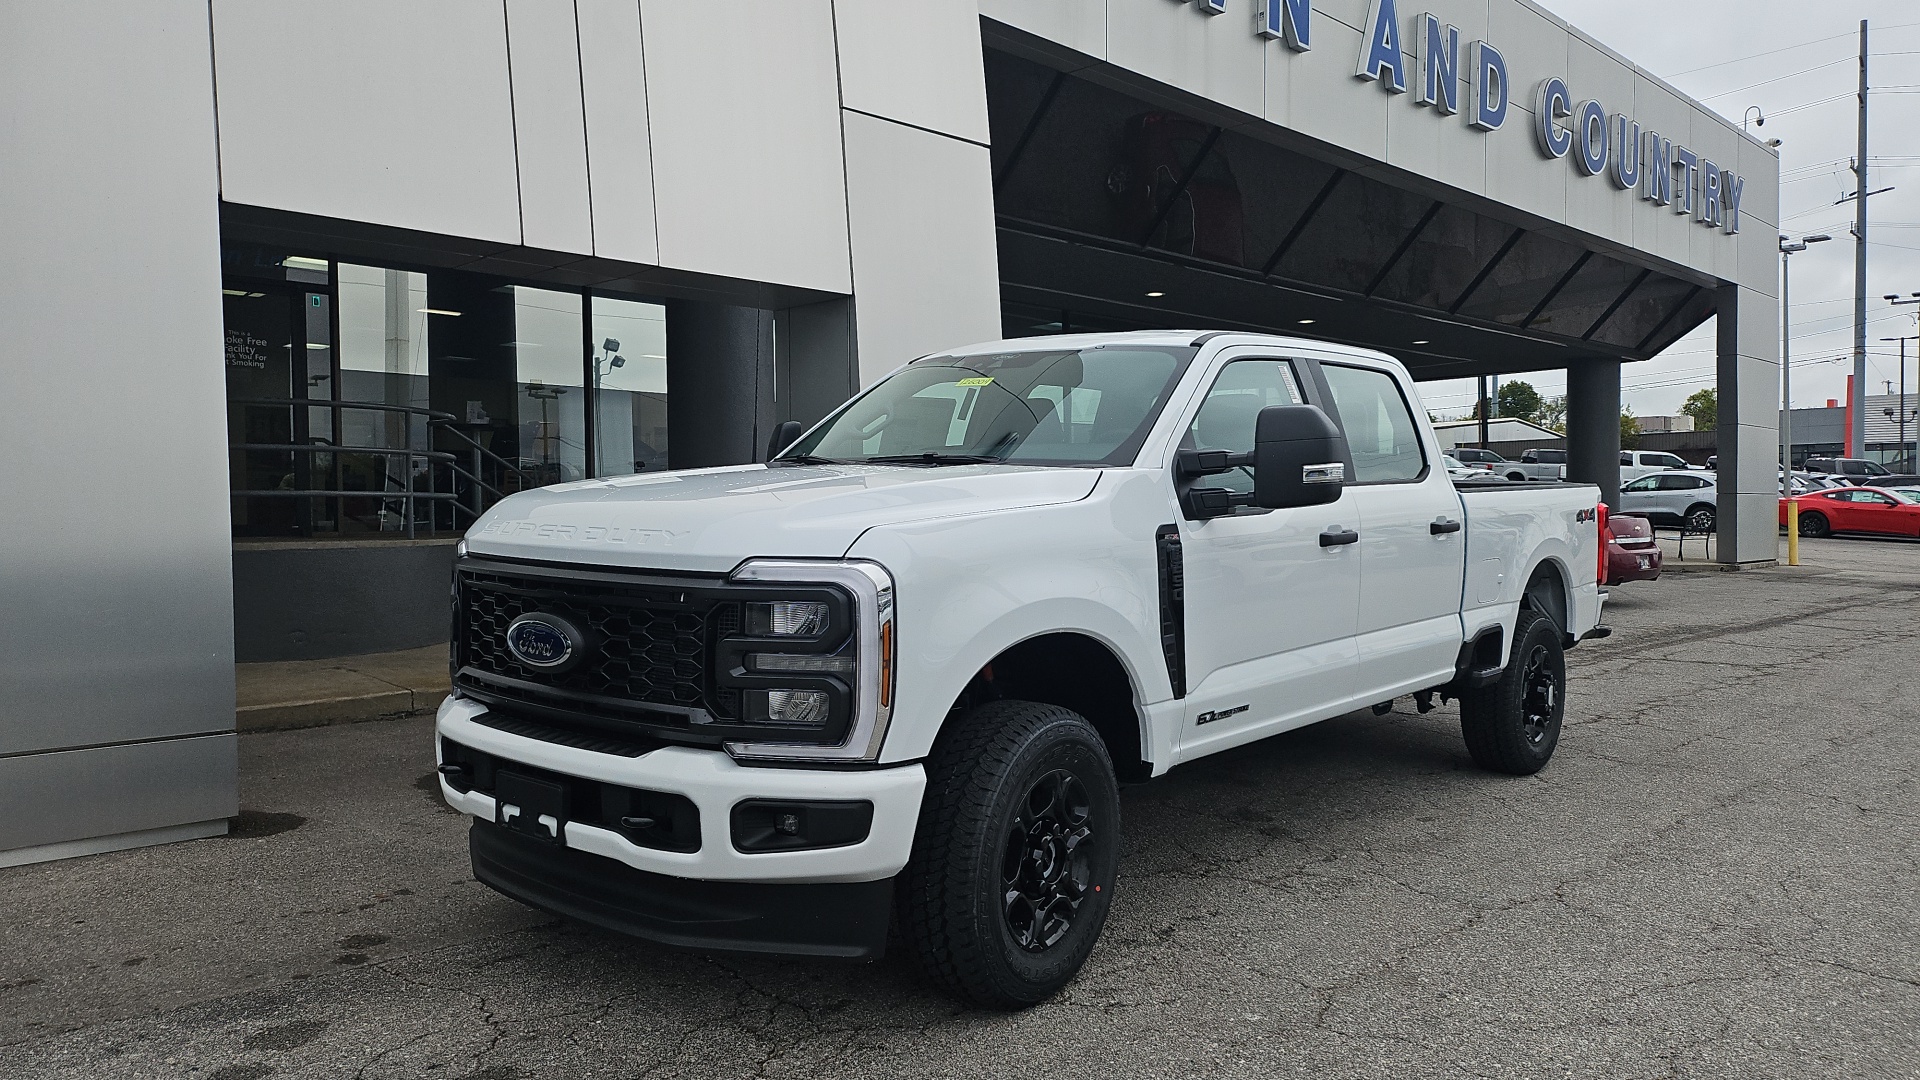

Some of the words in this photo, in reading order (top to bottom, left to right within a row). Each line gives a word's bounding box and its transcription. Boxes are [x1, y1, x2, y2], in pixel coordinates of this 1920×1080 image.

[1355, 0, 1511, 132] AND
[1536, 76, 1746, 235] COUNTRY
[226, 335, 244, 345] oke
[247, 337, 268, 347] Free
[231, 358, 265, 370] Smoking
[255, 353, 267, 362] For
[481, 520, 579, 541] SUPER
[580, 526, 691, 546] DUTY
[518, 627, 554, 658] Ford
